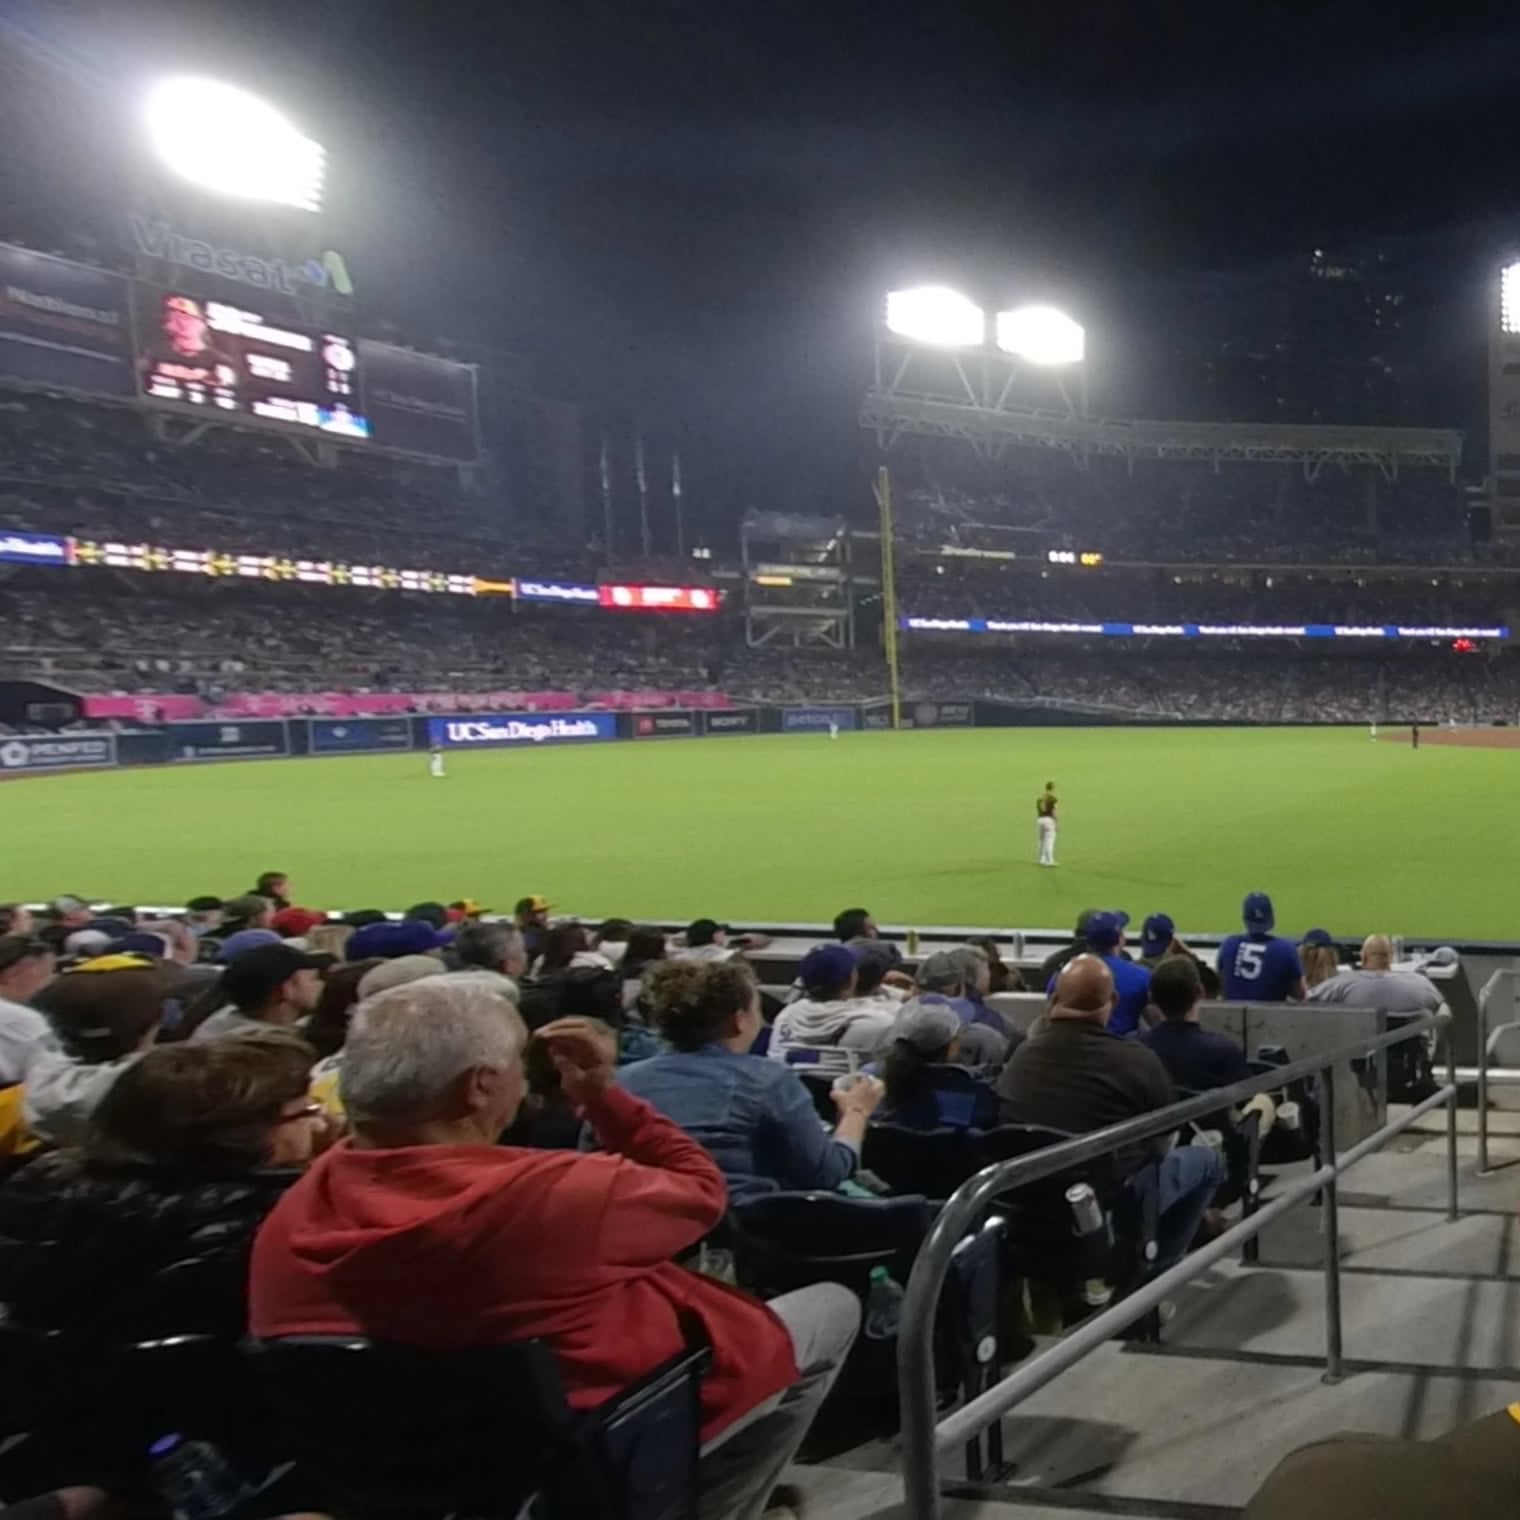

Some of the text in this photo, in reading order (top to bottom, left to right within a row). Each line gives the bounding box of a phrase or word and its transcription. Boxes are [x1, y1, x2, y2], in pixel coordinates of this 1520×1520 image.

[131, 215, 297, 296] Viasat
[446, 719, 598, 742] UC San Diego Health
